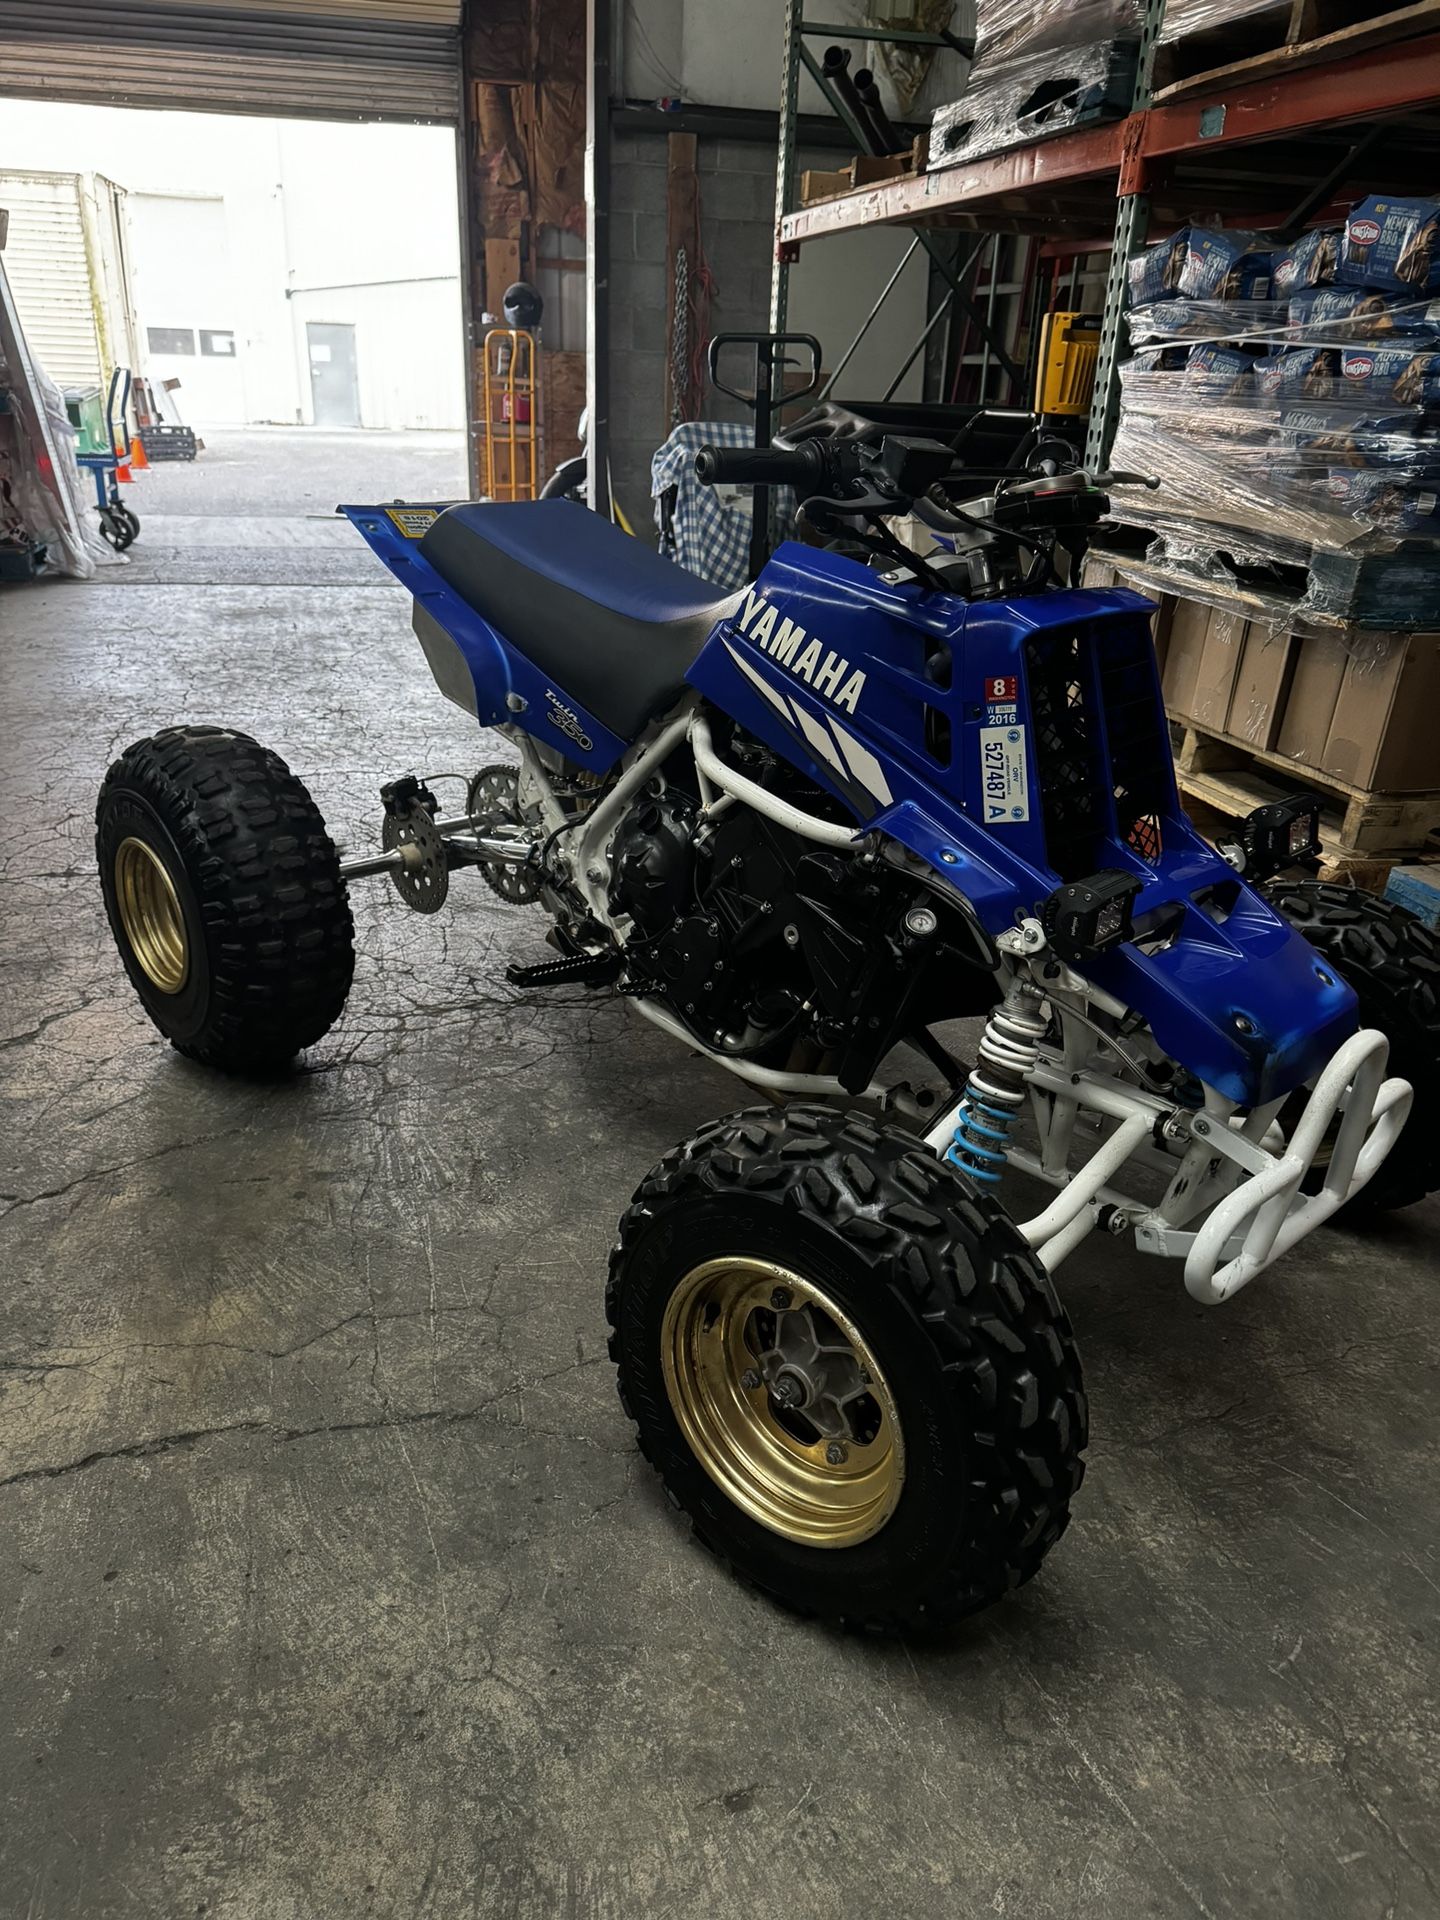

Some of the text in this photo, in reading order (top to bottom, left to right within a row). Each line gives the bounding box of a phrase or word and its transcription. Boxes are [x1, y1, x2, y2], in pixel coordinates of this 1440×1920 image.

[1379, 230, 1398, 246] BBQ
[736, 590, 867, 715] YAMAHA
[993, 678, 1006, 696] 8
[544, 688, 580, 722] Twin
[989, 713, 1016, 725] 2016
[547, 708, 593, 750] 350
[985, 742, 1006, 819] 527487 A
